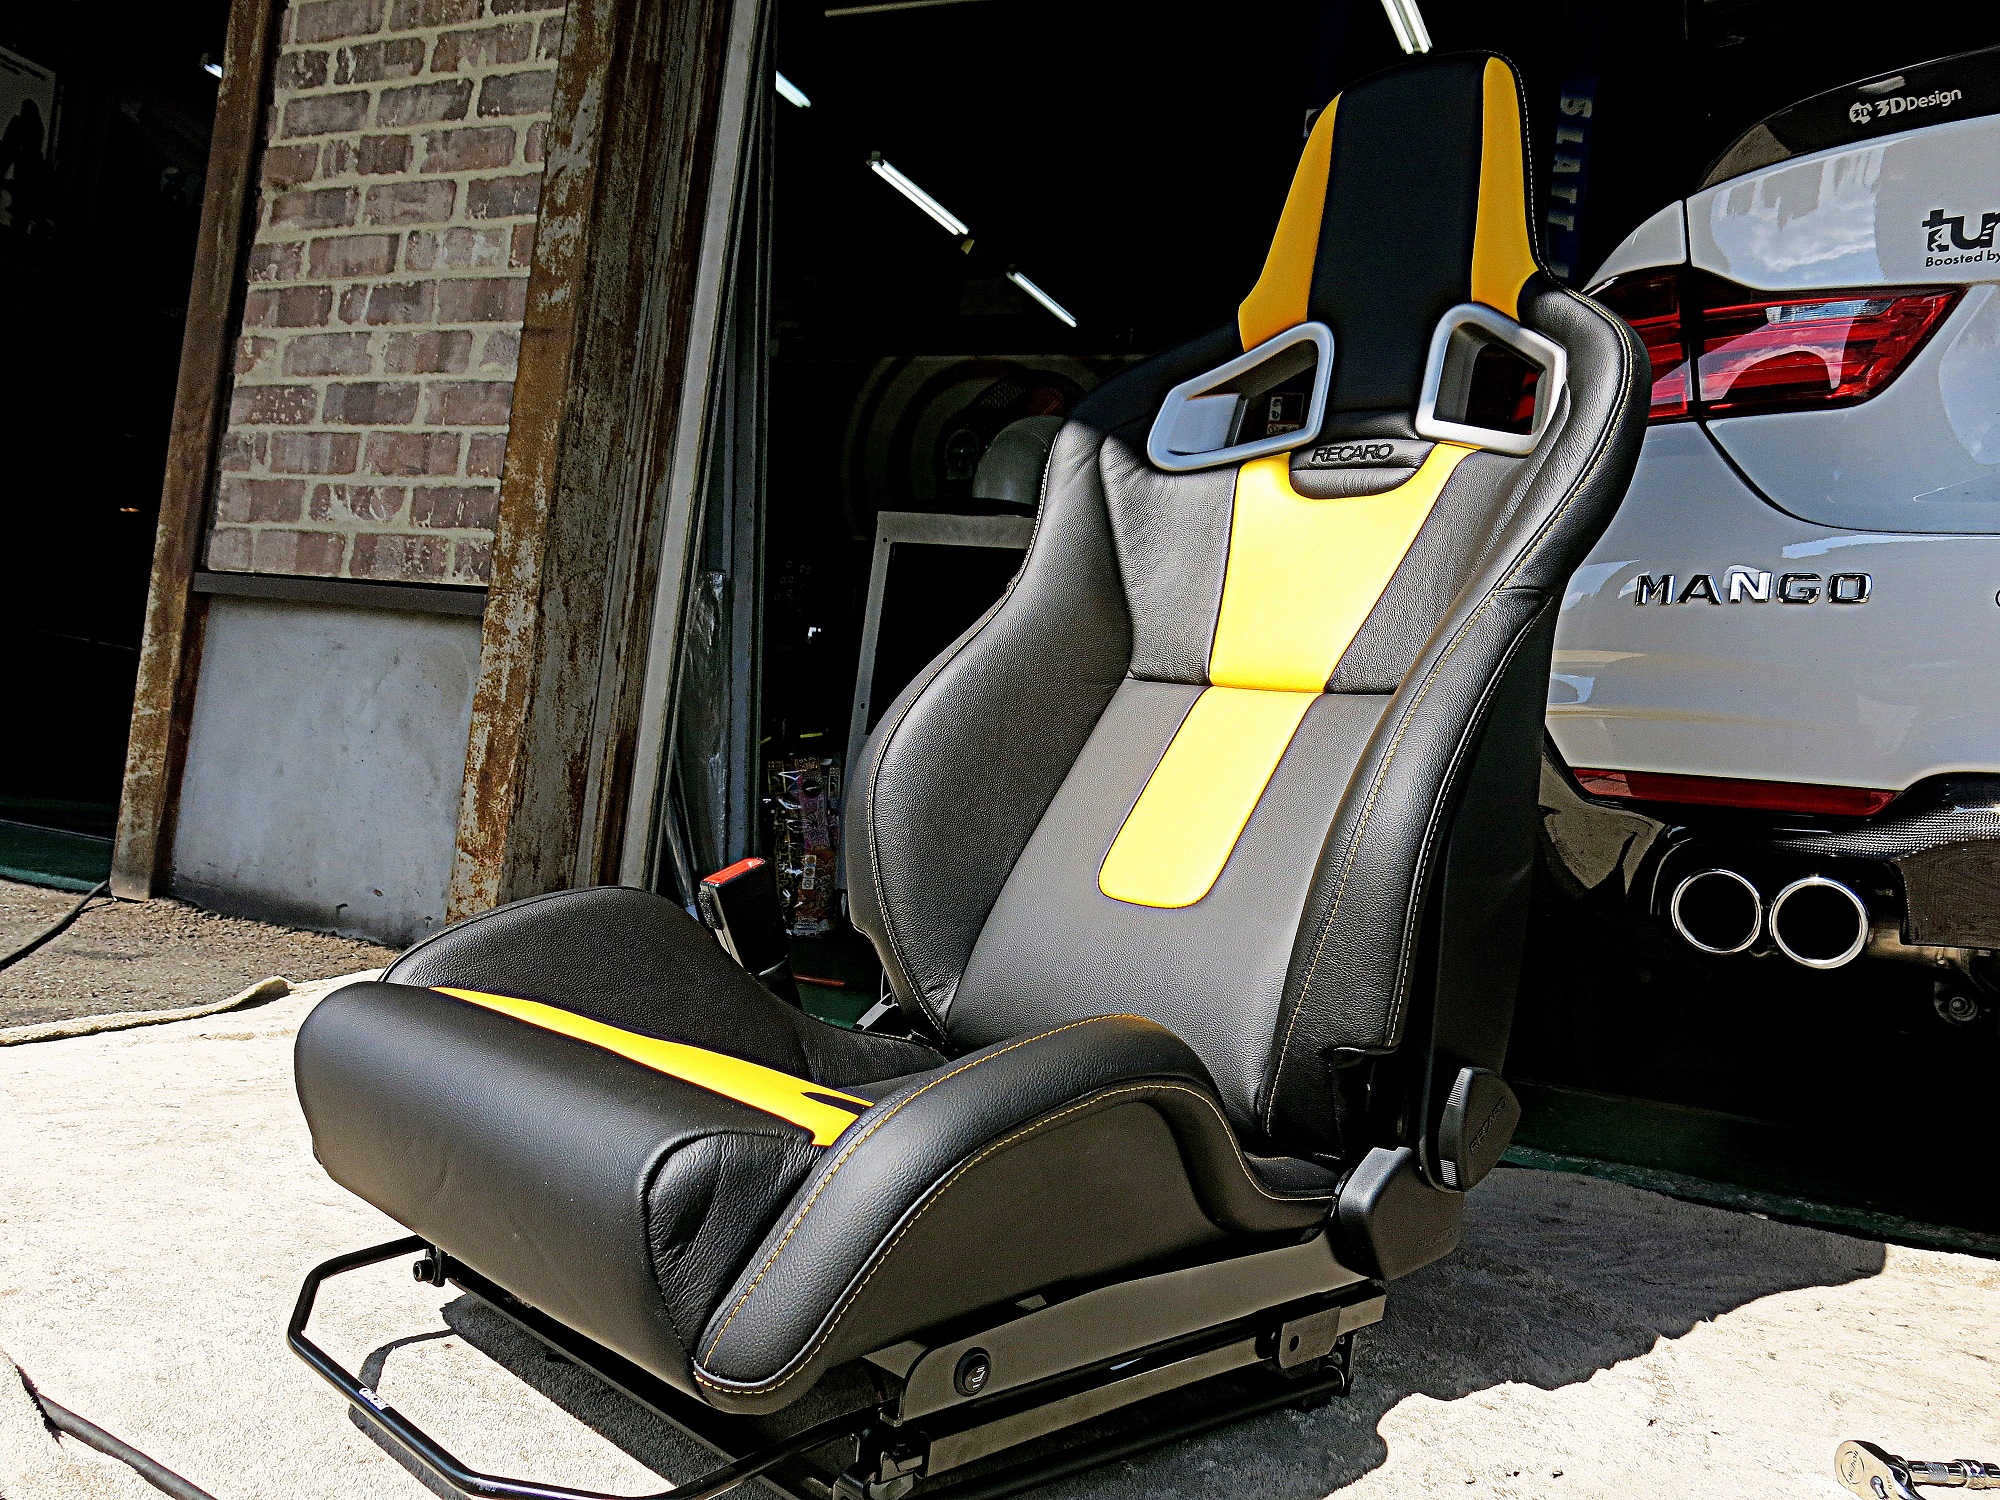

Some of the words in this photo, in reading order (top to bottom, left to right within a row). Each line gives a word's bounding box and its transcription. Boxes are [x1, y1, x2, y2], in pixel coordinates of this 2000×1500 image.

[1925, 251, 1983, 267] Boosted
[1311, 443, 1395, 462] RECARO
[1635, 571, 1873, 605] MANGO
